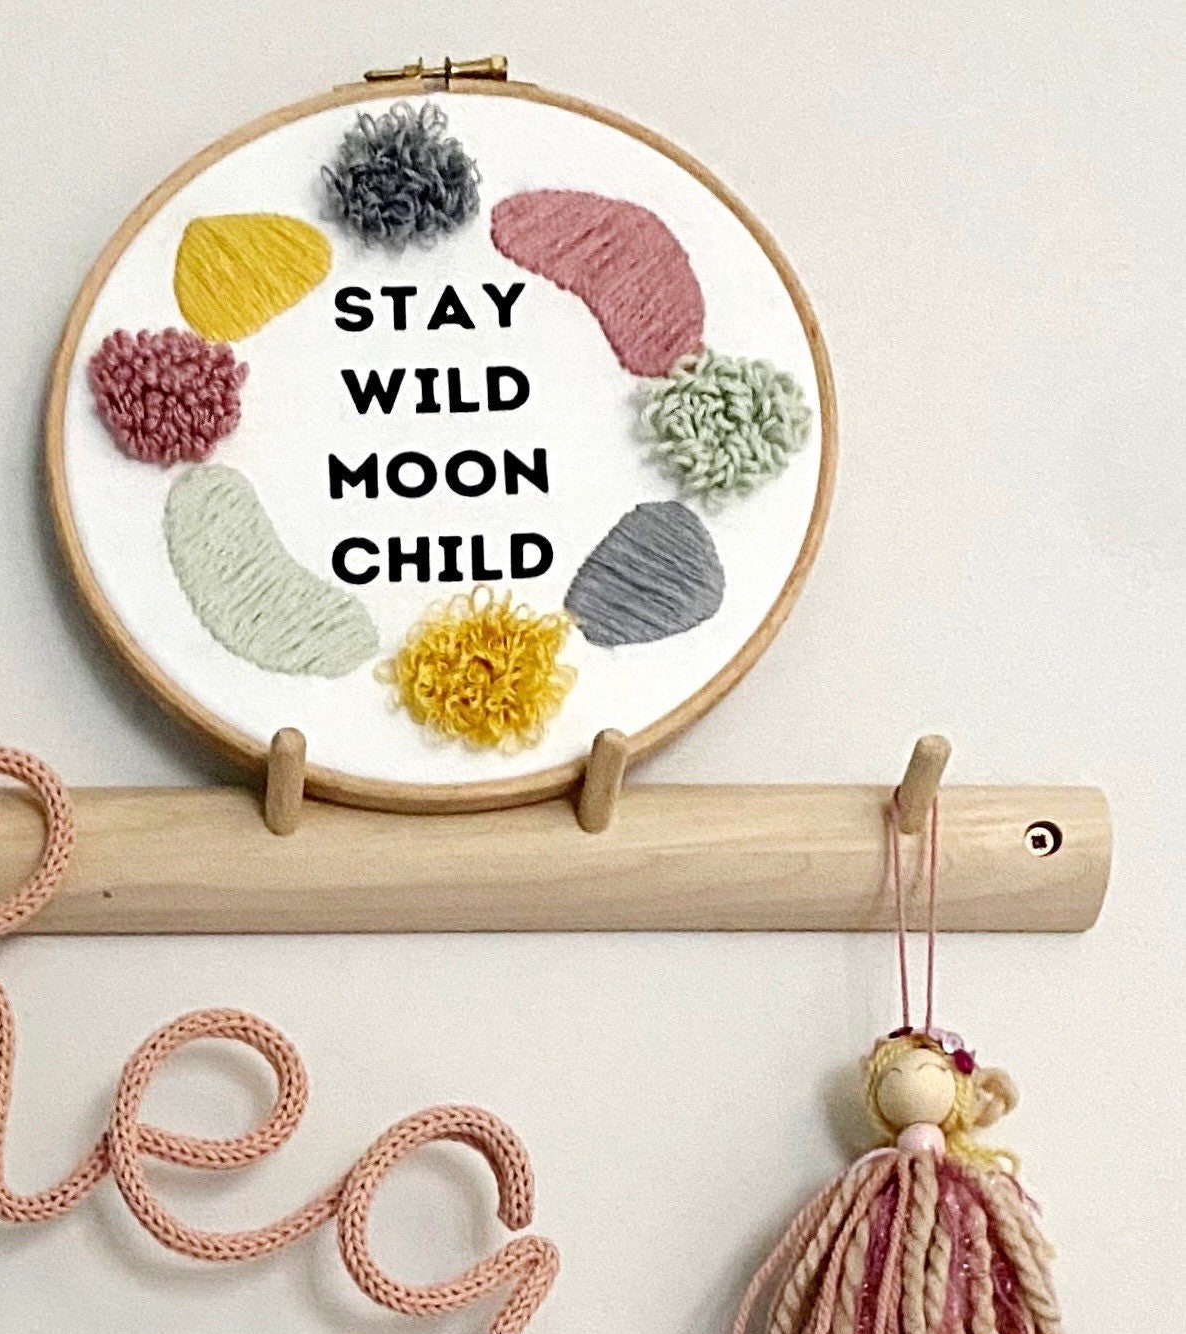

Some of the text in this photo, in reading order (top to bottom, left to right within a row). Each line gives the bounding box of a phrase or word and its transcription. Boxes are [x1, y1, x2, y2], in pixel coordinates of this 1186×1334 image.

[334, 283, 526, 331] STAY
[340, 366, 530, 414] WILD
[328, 448, 549, 499] MOON
[331, 533, 554, 585] CHILD
